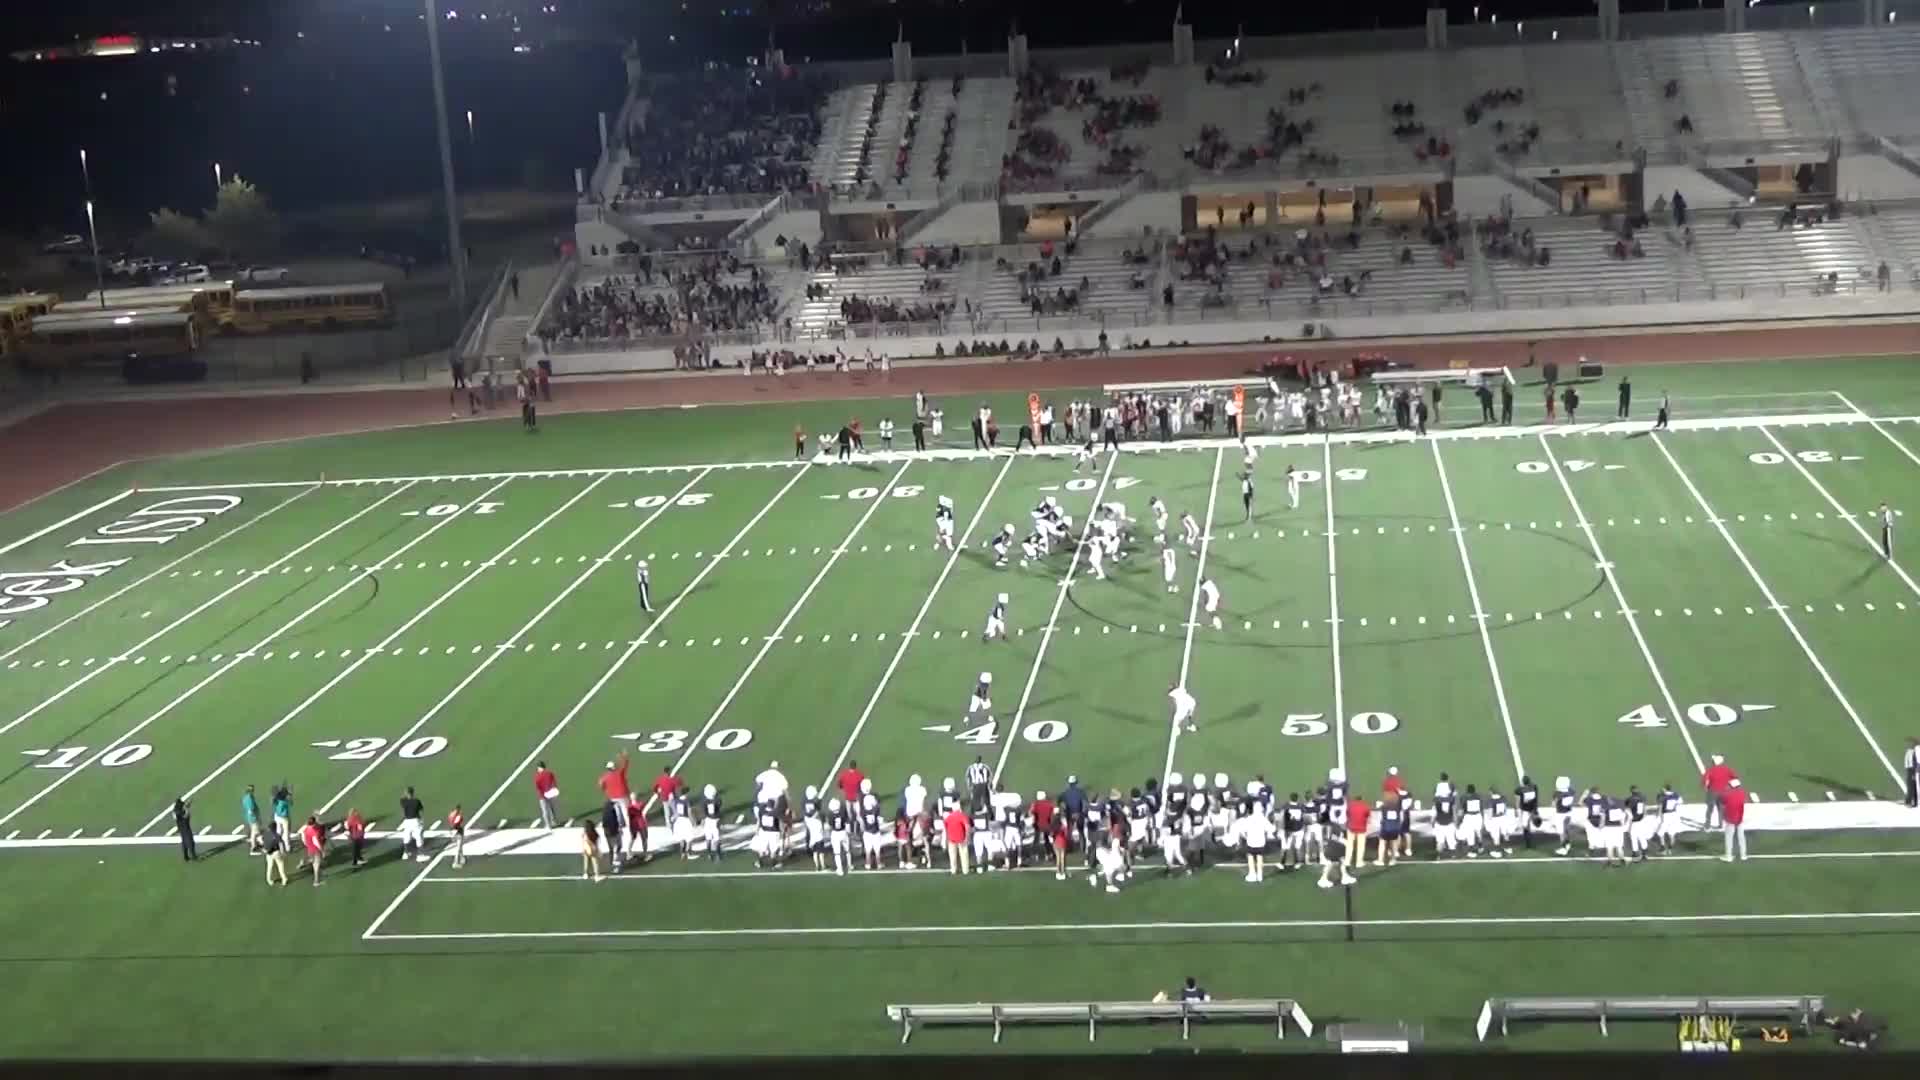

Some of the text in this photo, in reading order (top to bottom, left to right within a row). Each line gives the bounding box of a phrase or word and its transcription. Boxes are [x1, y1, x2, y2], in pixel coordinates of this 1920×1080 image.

[425, 502, 505, 516] 10
[0, 495, 242, 628] eek ISD
[1281, 711, 1400, 736] 50
[1617, 703, 1737, 728] 40
[638, 728, 753, 752] 30
[954, 721, 1069, 744] 40
[35, 744, 153, 768] 10
[329, 736, 448, 760] 20
